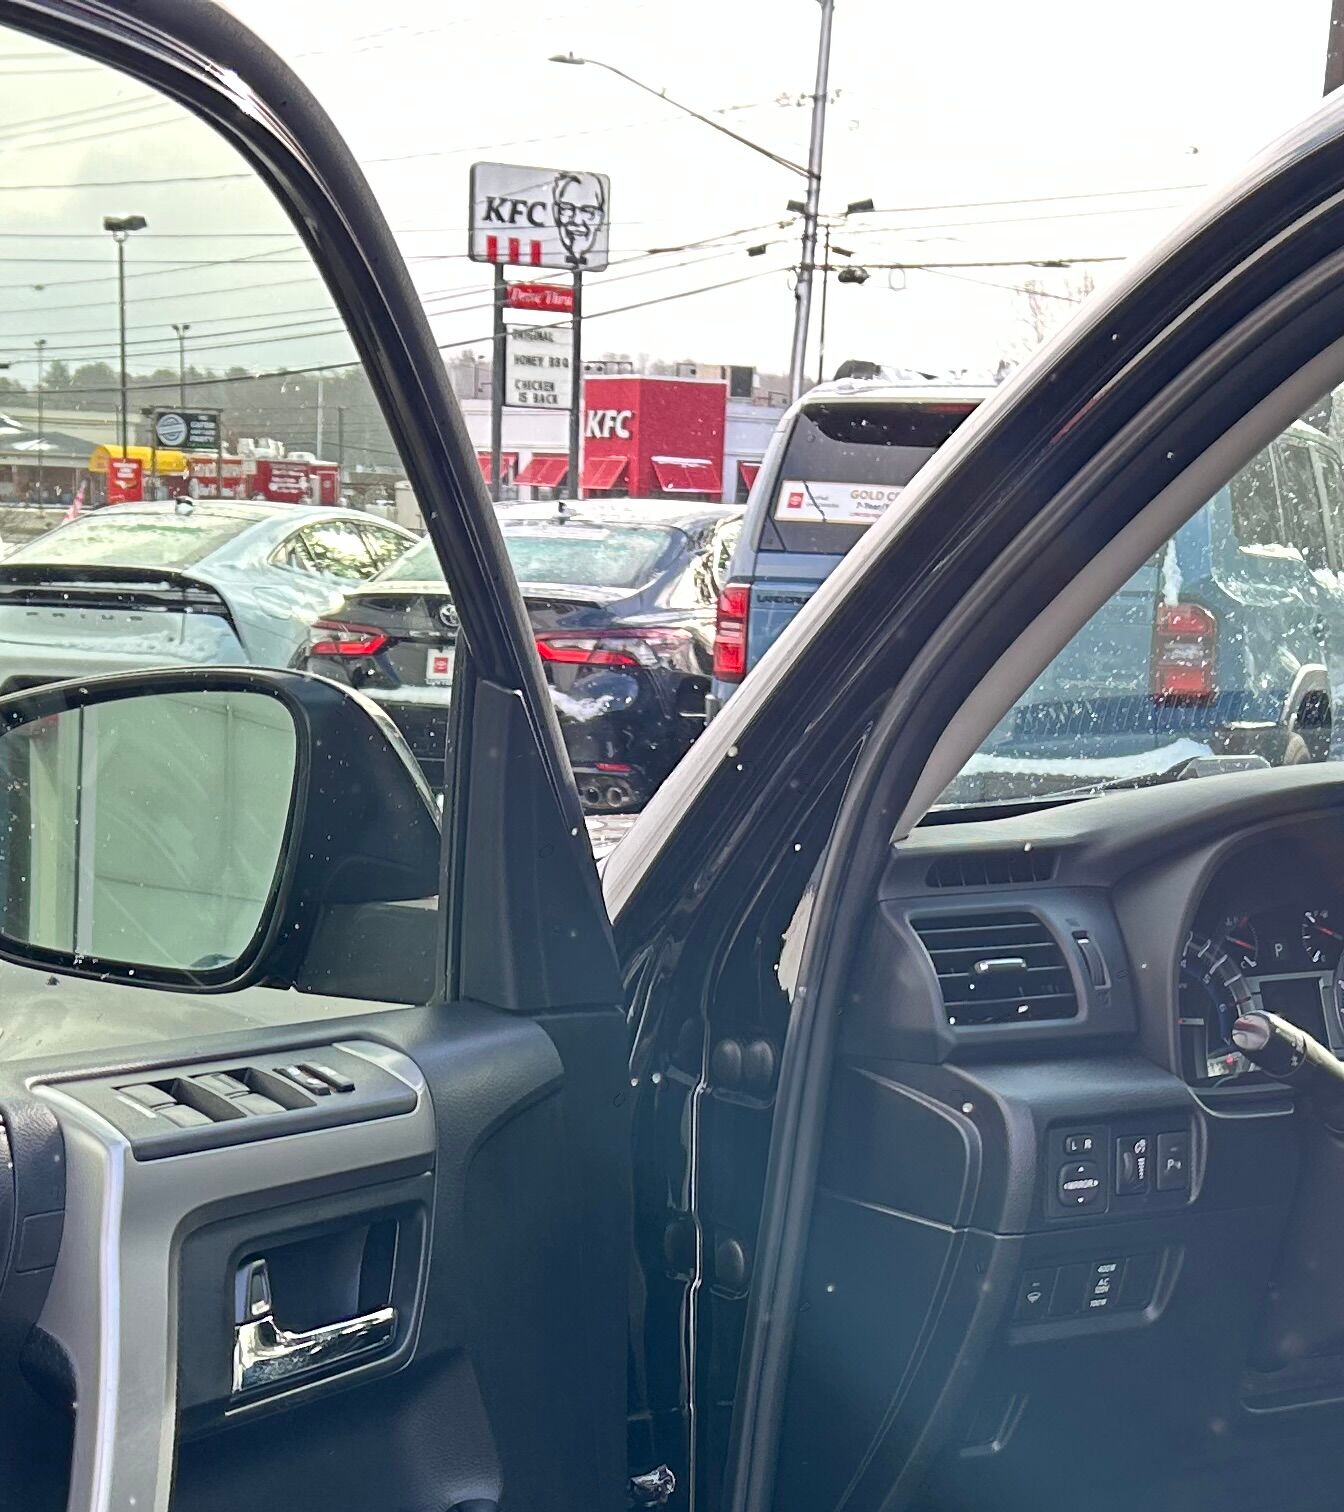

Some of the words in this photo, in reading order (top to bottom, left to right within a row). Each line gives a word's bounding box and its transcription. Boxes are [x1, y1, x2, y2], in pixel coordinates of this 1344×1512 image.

[483, 196, 546, 227] KFC
[514, 354, 543, 368] HONEY
[515, 379, 554, 392] CHICKEN
[533, 393, 558, 405] BACK
[585, 409, 632, 439] KFC
[851, 489, 885, 501] GOLD
